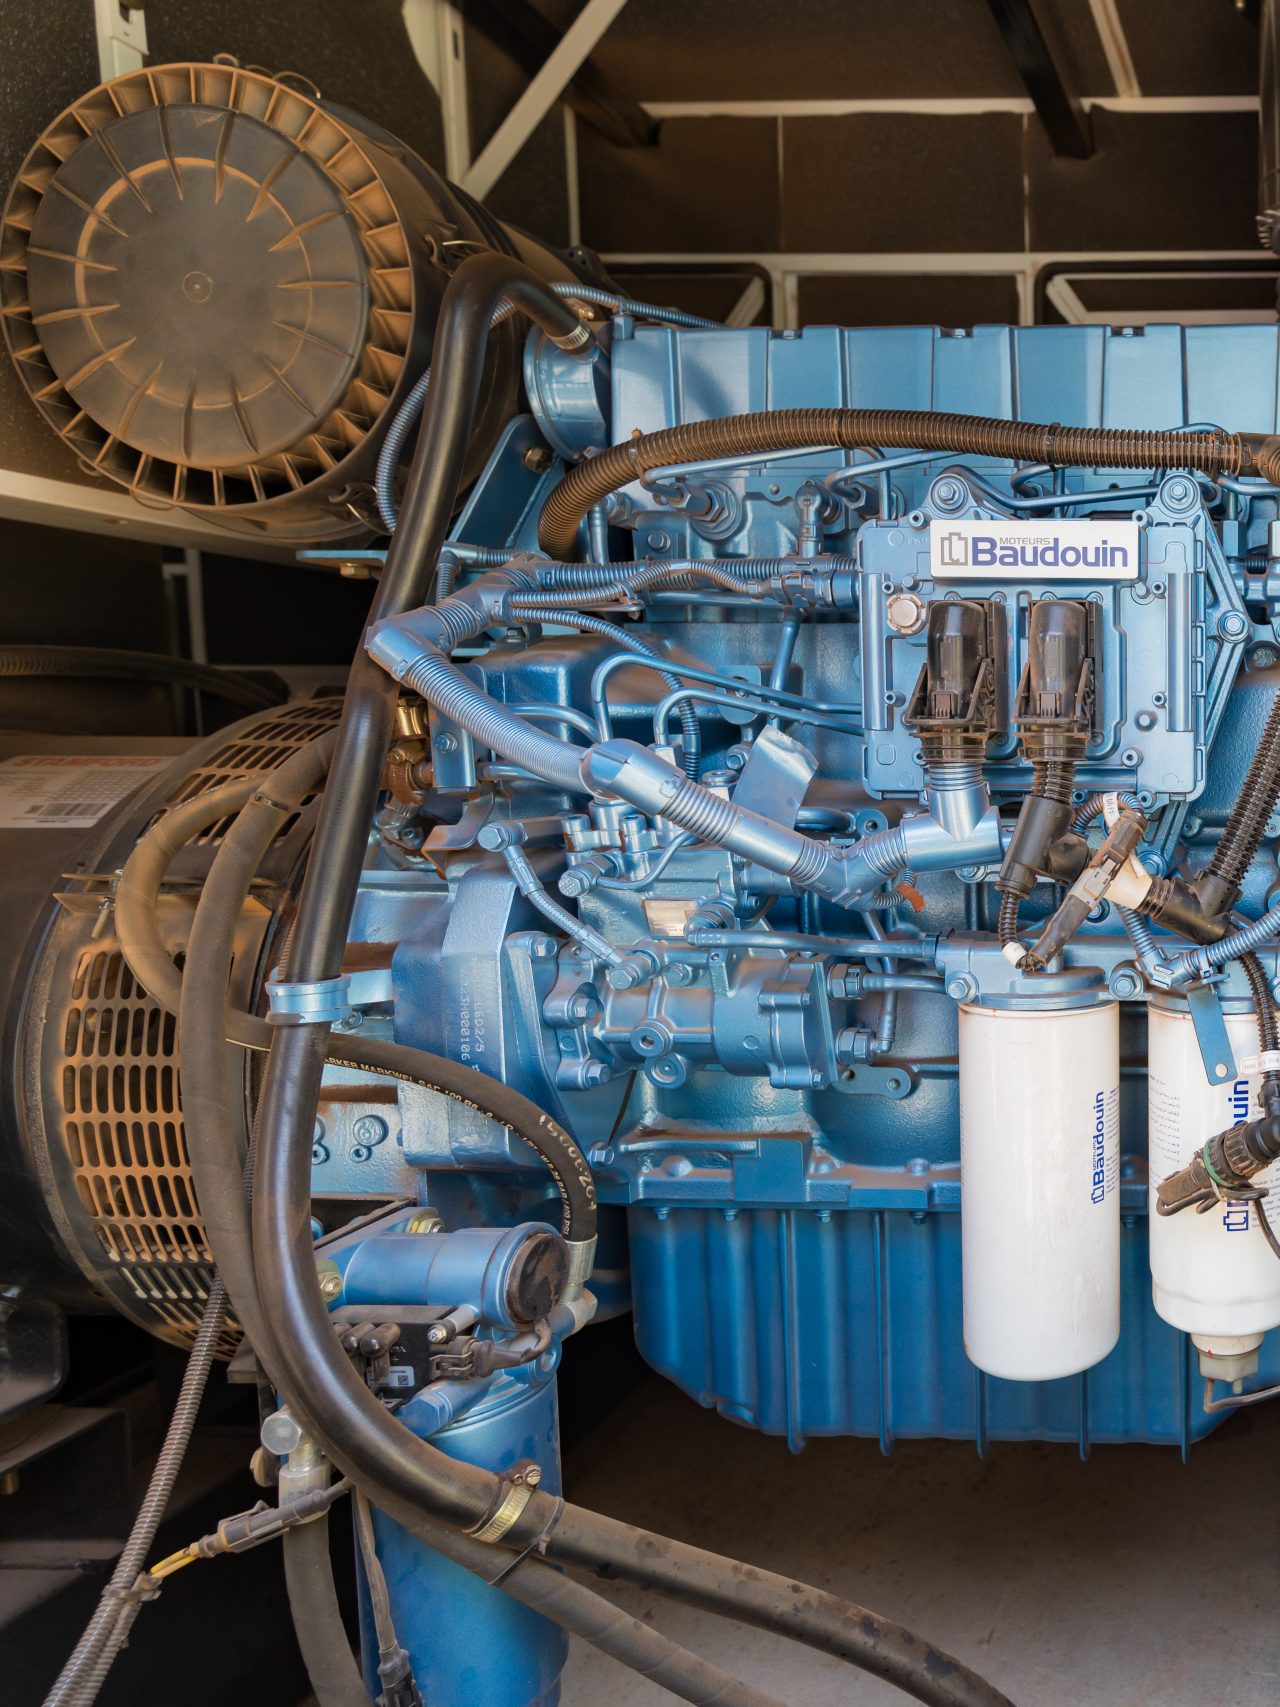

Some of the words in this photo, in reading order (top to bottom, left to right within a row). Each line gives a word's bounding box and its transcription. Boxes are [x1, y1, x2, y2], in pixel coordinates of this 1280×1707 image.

[971, 536, 1128, 567] Baudouin
[1000, 537, 1051, 546] MOTEURS
[13, 757, 161, 767] STAMFORD
[1092, 1090, 1105, 1186] Baudouin
